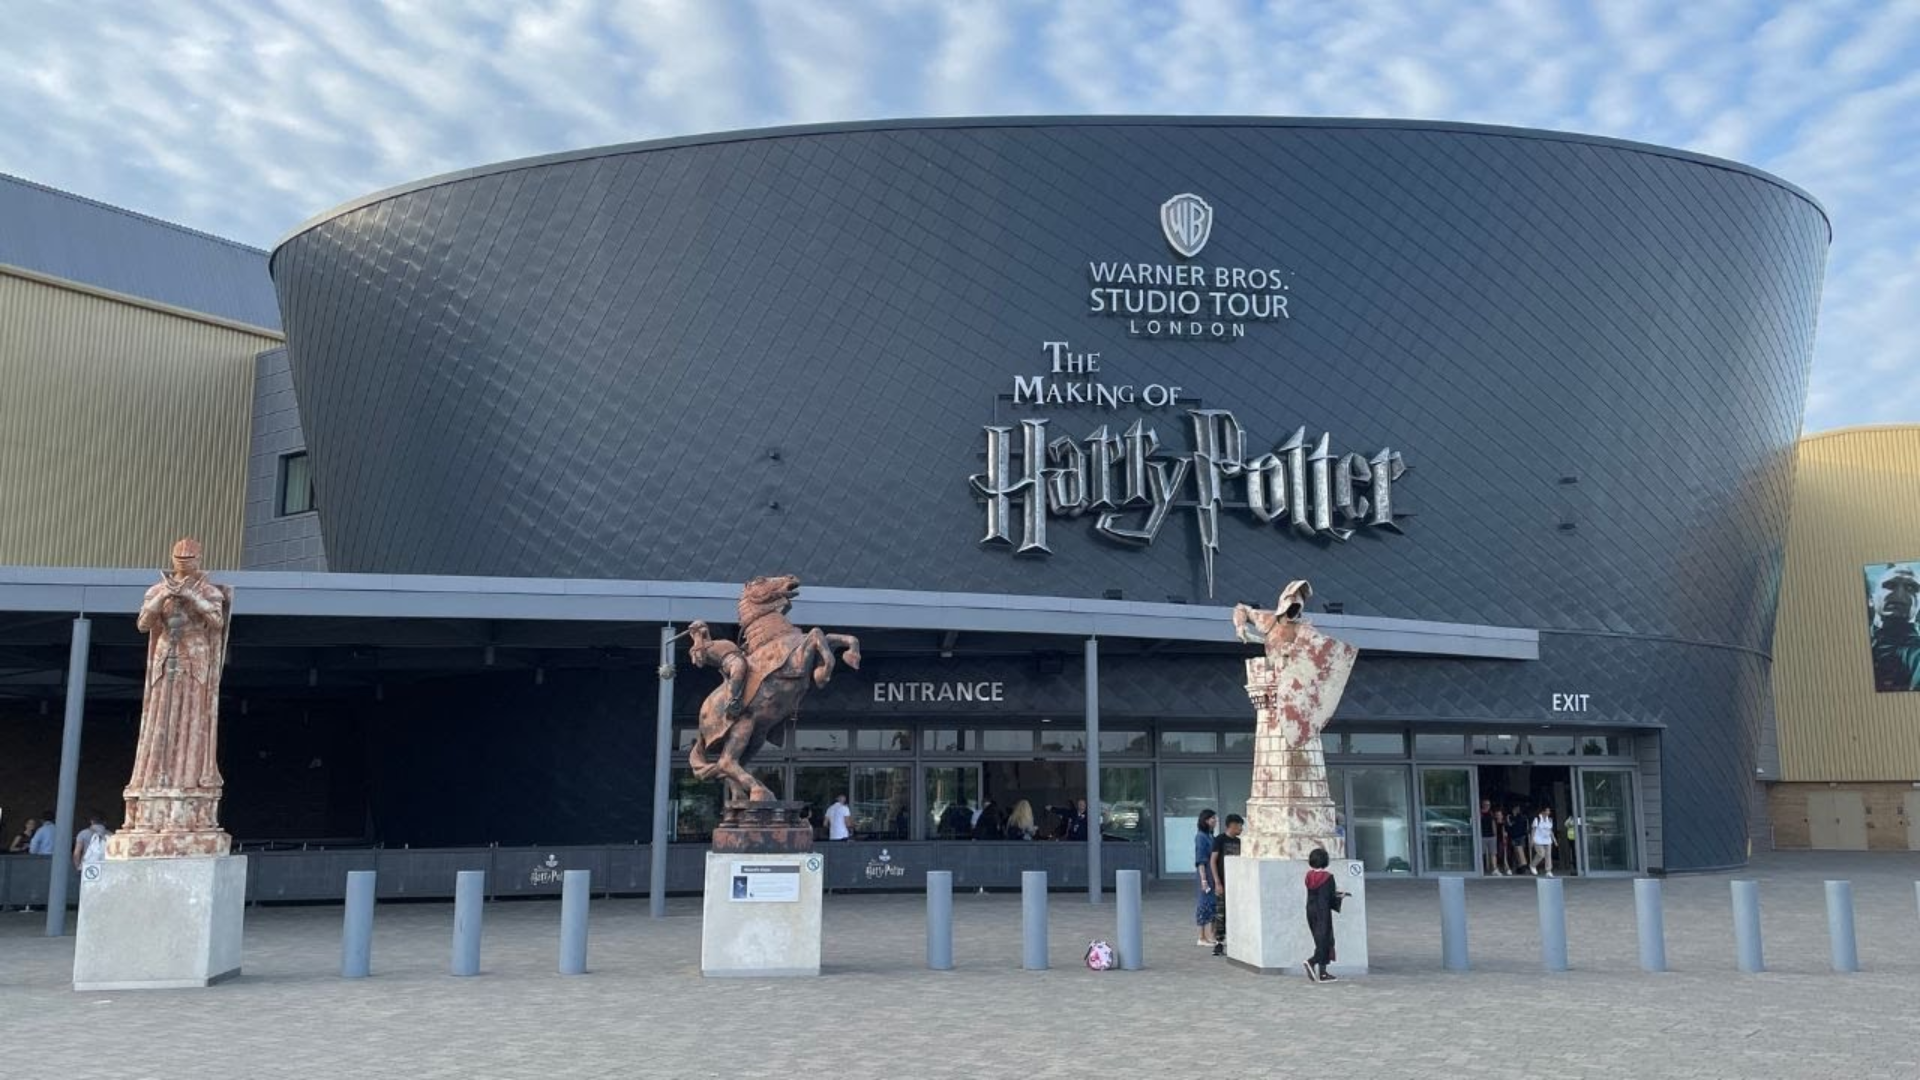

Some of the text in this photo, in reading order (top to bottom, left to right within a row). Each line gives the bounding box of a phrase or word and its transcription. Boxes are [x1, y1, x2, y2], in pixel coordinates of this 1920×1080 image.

[1168, 201, 1207, 249] WB
[1090, 261, 1289, 290] WARNER BROS.
[1090, 288, 1290, 318] STUDIO TOUR
[1130, 319, 1245, 337] LONDON
[1142, 383, 1182, 407] OF
[969, 409, 1411, 598] Harry Potter
[873, 682, 1004, 702] ENTRANCE
[1552, 693, 1590, 712] EXIT
